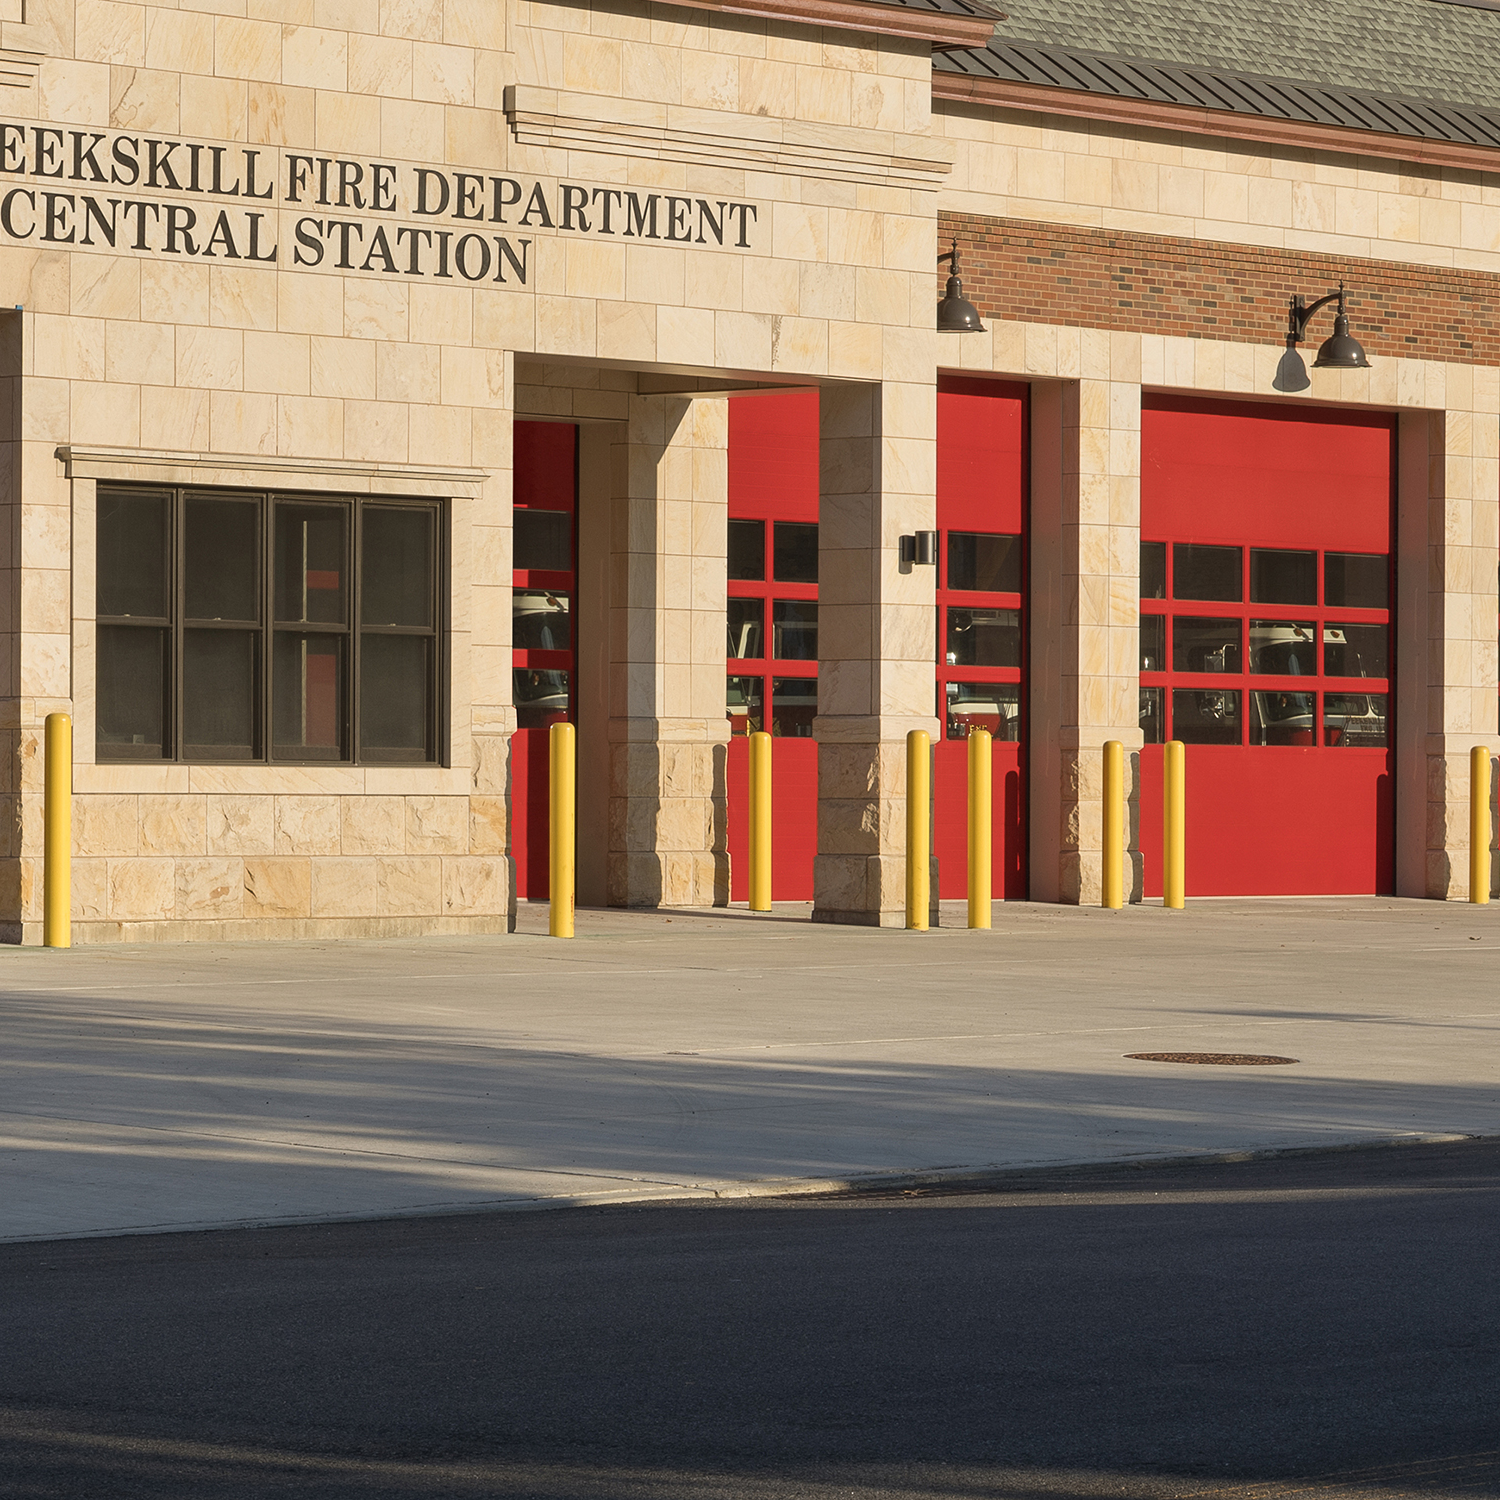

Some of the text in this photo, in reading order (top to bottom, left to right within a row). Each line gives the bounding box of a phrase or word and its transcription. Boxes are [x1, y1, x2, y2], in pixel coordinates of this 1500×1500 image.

[0, 187, 532, 285] CENTRAL STATION
[284, 154, 397, 212] FIRE
[412, 167, 758, 248] DEPARTMENT
